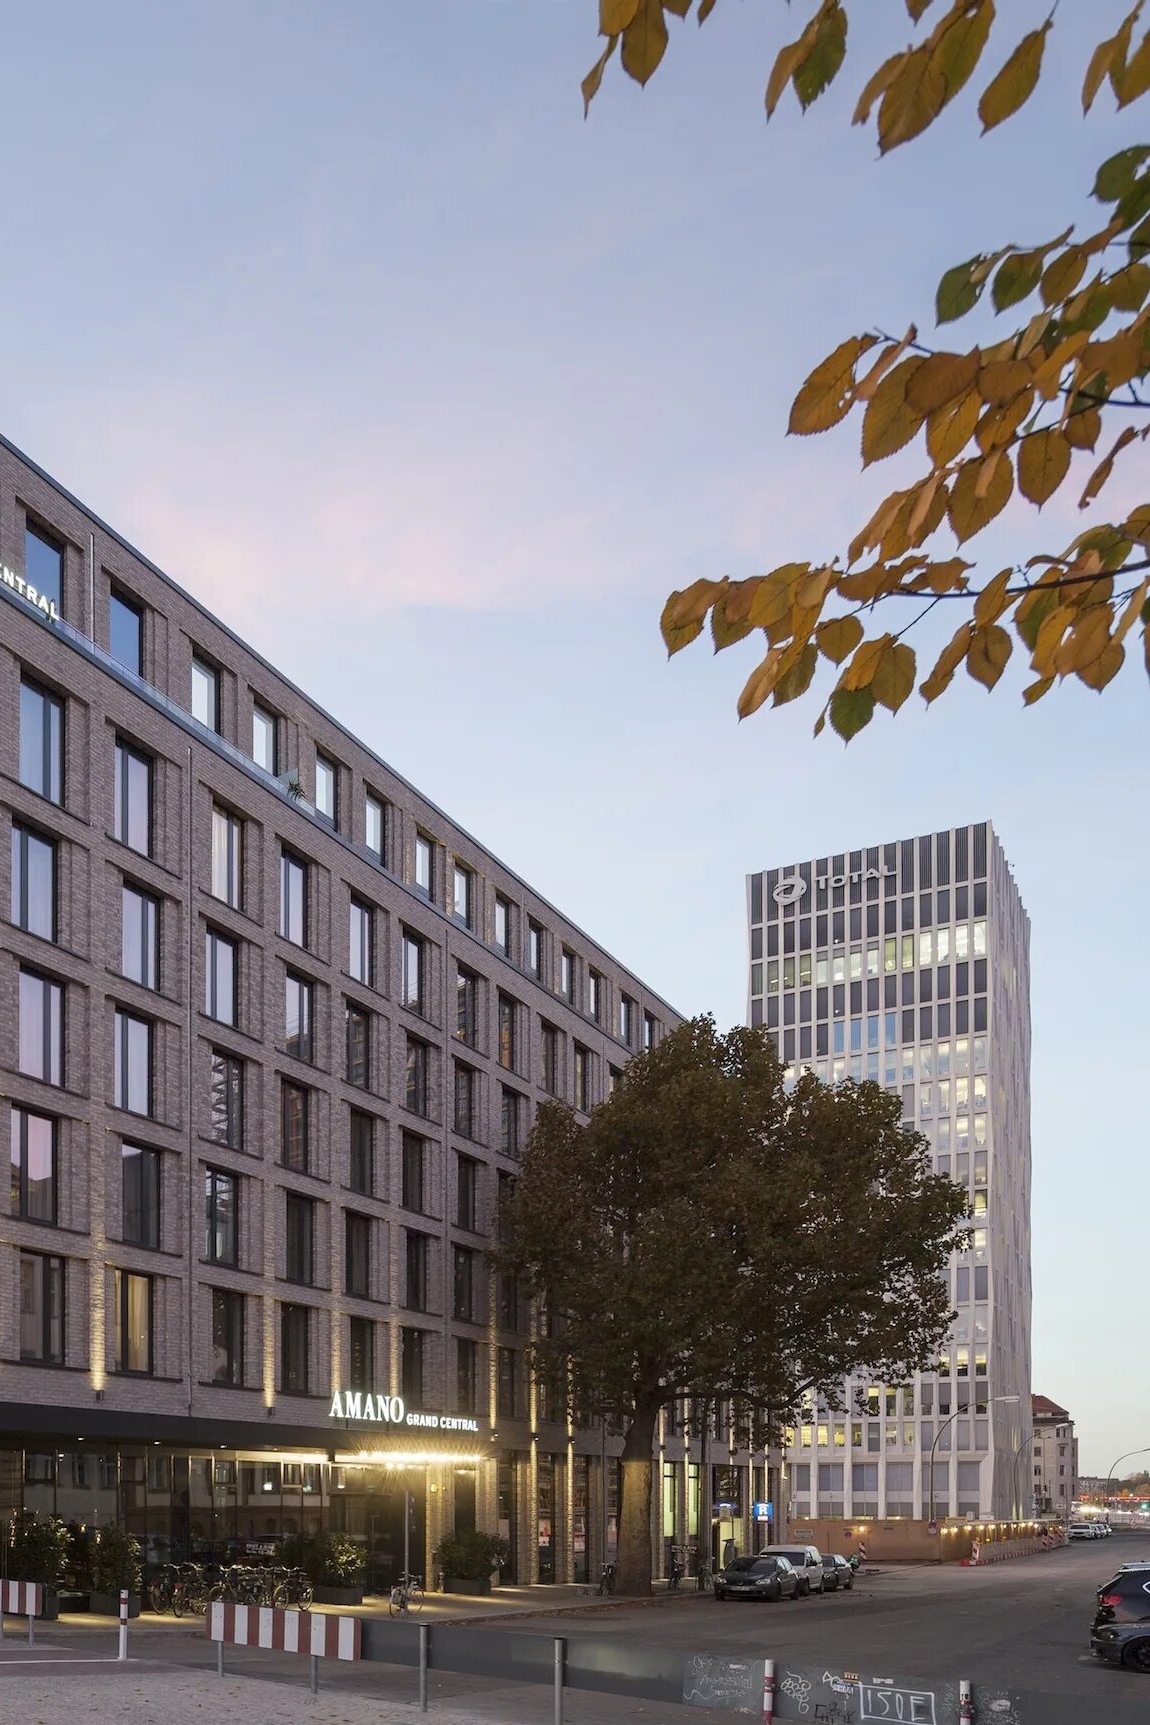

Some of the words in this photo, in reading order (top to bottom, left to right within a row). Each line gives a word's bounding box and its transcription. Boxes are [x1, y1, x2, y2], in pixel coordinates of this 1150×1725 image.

[815, 865, 897, 890] TOTAL
[328, 1390, 405, 1423] AMANO
[406, 1413, 439, 1428] GRAND
[440, 1417, 479, 1432] CENTRAL
